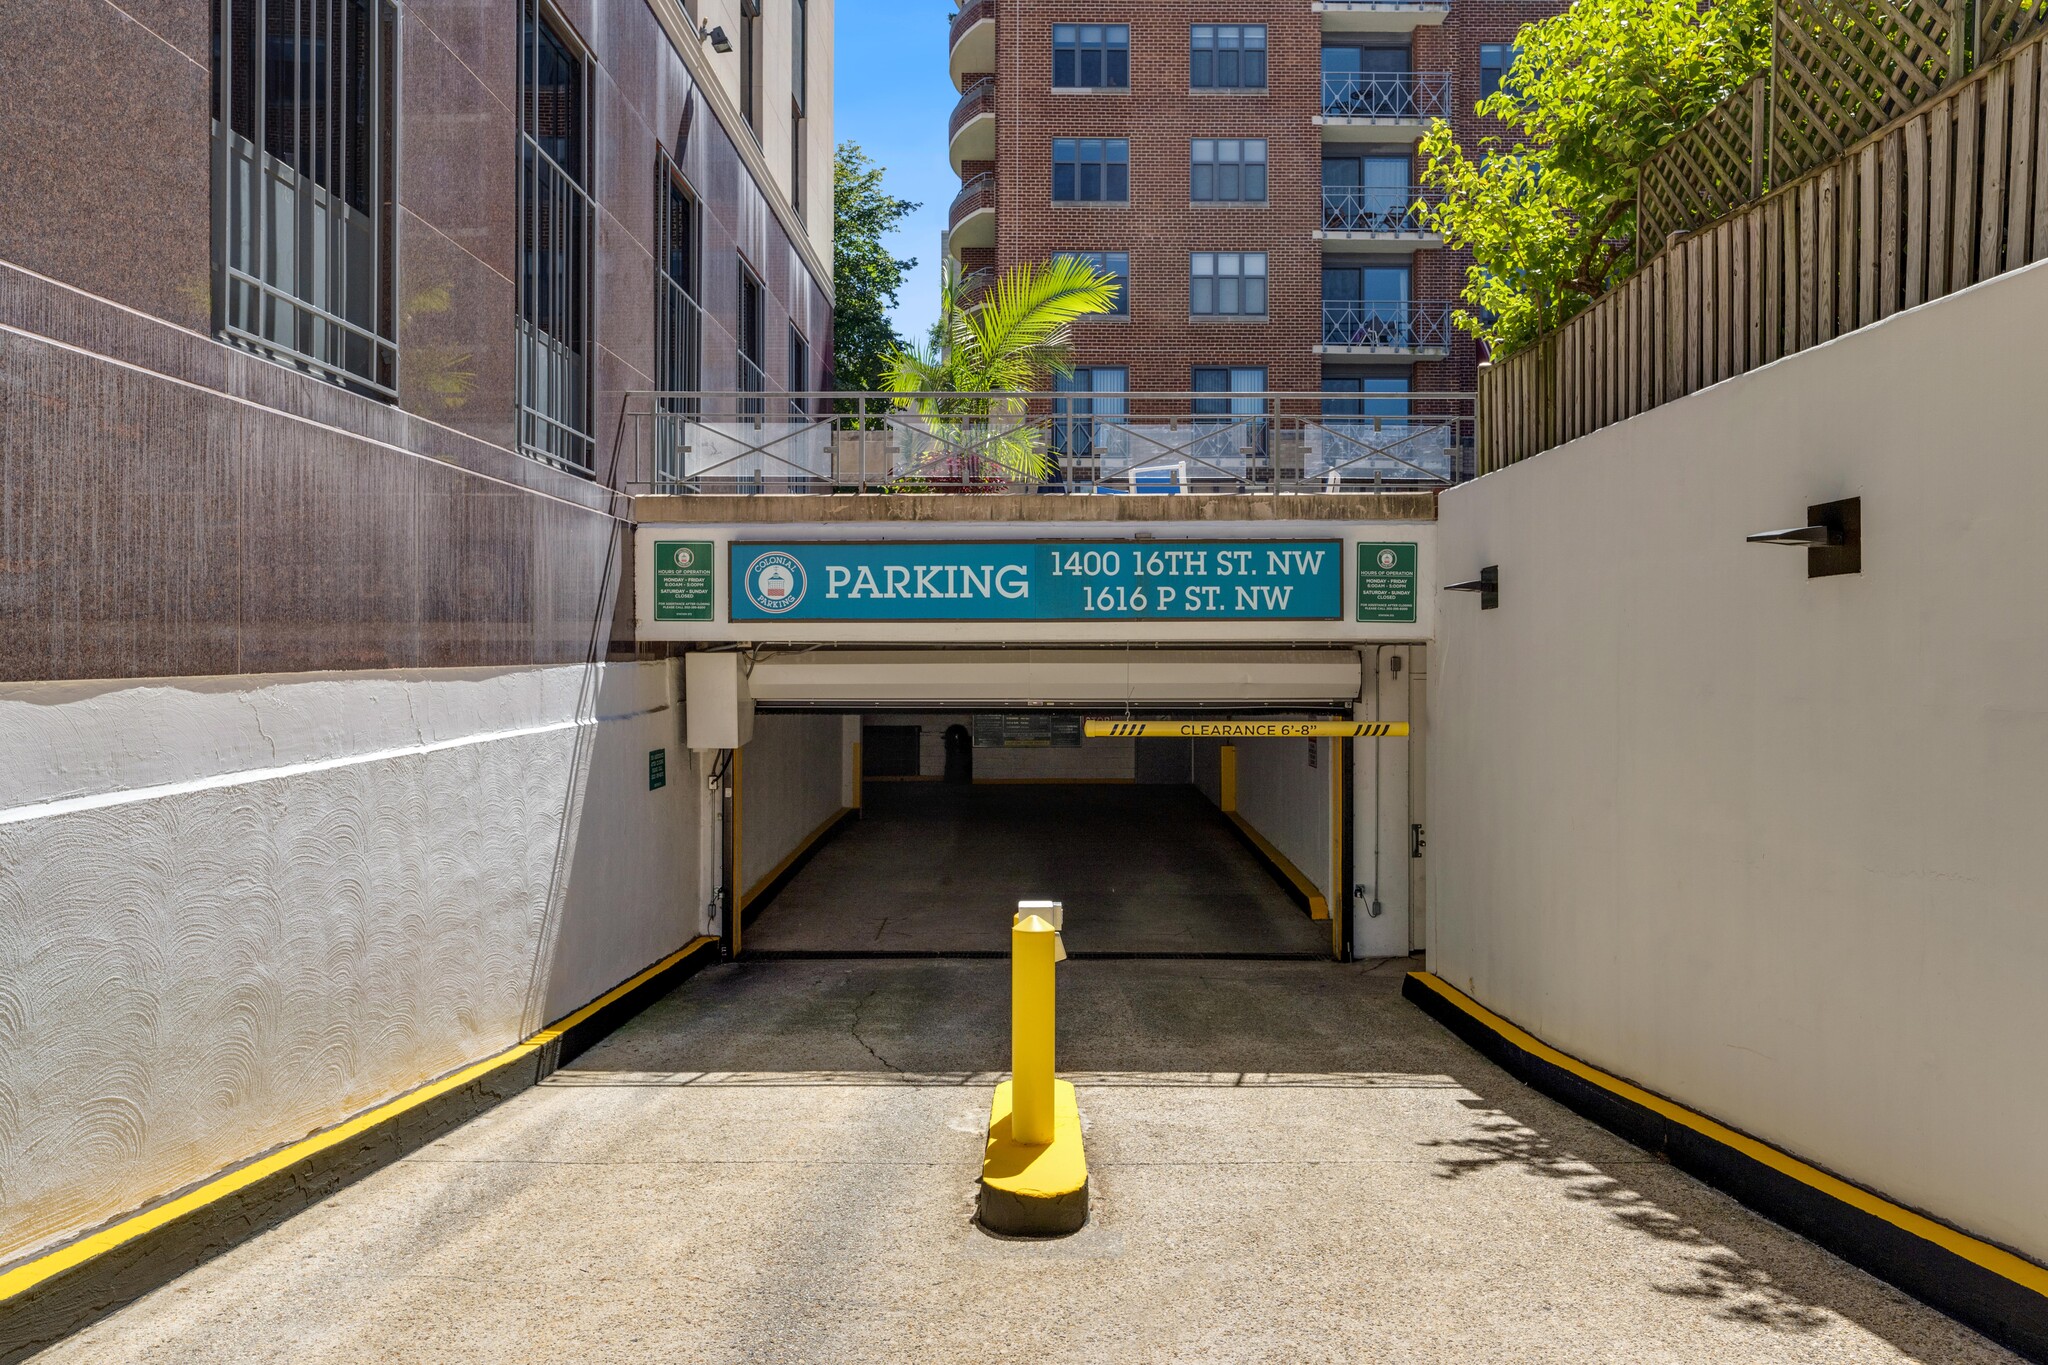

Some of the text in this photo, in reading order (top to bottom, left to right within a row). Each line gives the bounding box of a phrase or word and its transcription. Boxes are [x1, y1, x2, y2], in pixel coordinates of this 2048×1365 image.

[754, 556, 797, 573] COLONIAL
[1051, 551, 1325, 576] 1400 16TH ST. NW
[825, 564, 1029, 599] PARKING
[757, 594, 796, 608] PARKING
[1083, 586, 1294, 611] 1616 P ST. NW
[1180, 724, 1277, 736] CLEARANCE
